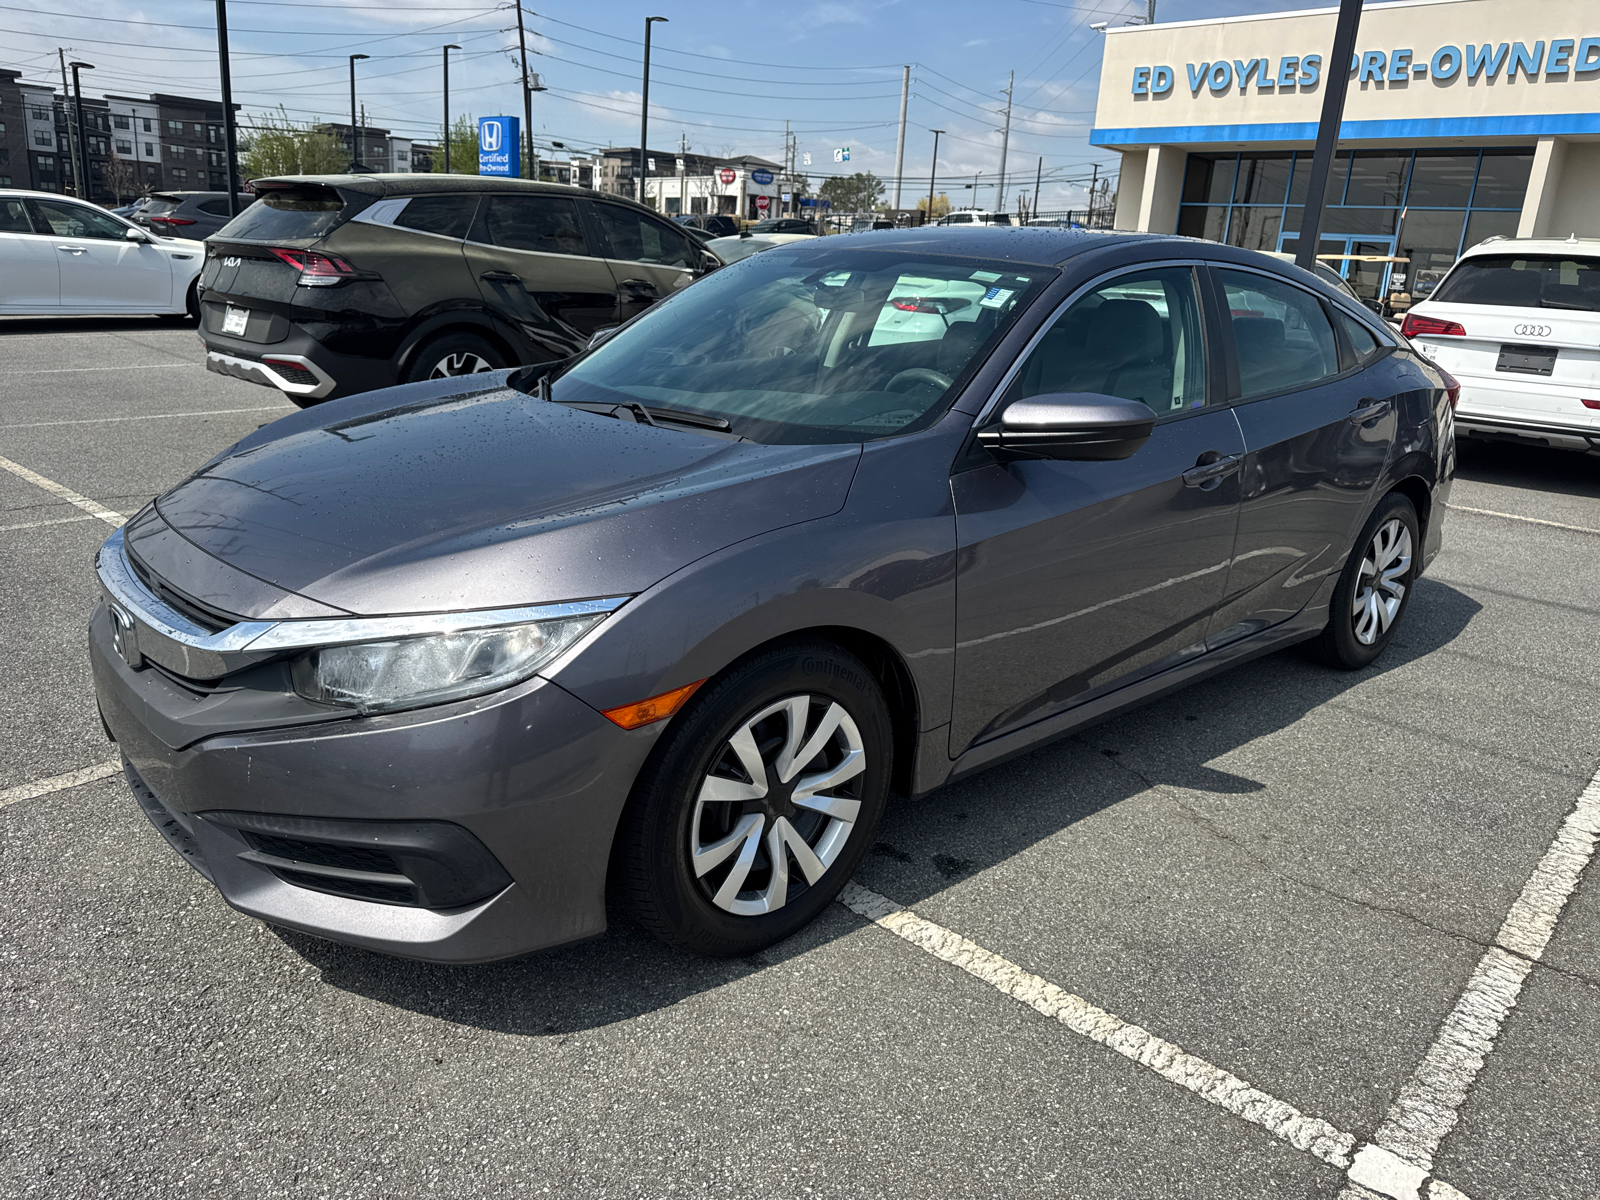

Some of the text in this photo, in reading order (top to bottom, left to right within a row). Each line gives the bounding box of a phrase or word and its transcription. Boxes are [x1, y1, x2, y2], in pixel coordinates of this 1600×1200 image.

[1132, 66, 1173, 95] ED
[1186, 54, 1321, 92] VOYLES
[479, 153, 508, 162] Certified
[802, 656, 866, 692] Continental
